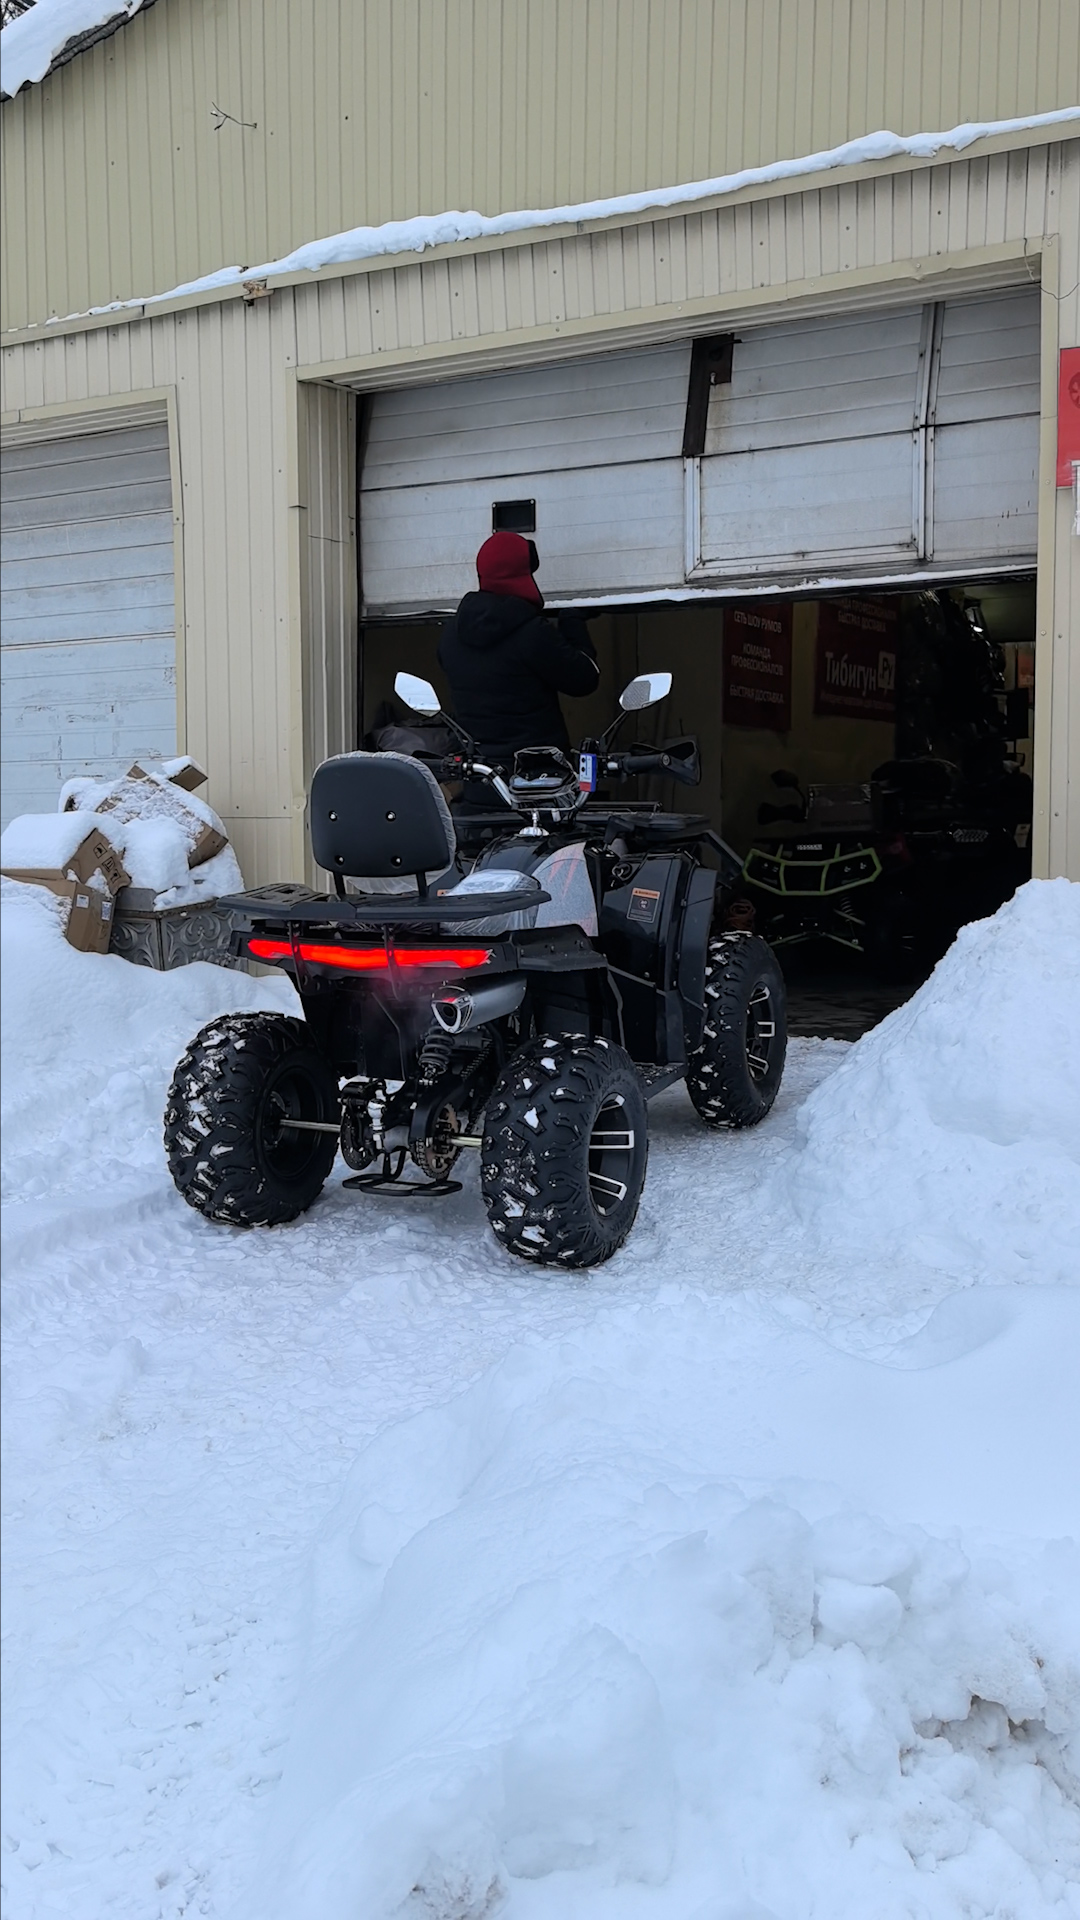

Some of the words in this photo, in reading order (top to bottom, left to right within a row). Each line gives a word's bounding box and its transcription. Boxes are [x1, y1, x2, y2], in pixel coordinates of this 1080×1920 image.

[733, 610, 748, 625] СЕТЬ
[747, 614, 761, 628] ШОУ
[761, 617, 783, 634] РУМОВ
[742, 642, 772, 661] КОМАНДА
[731, 654, 785, 676] ПРОФЕССИОНАЛОВ
[825, 651, 877, 697] Тибигун
[729, 684, 755, 700] БЫСТРАЯ
[754, 688, 785, 704] ДОСТАВКА
